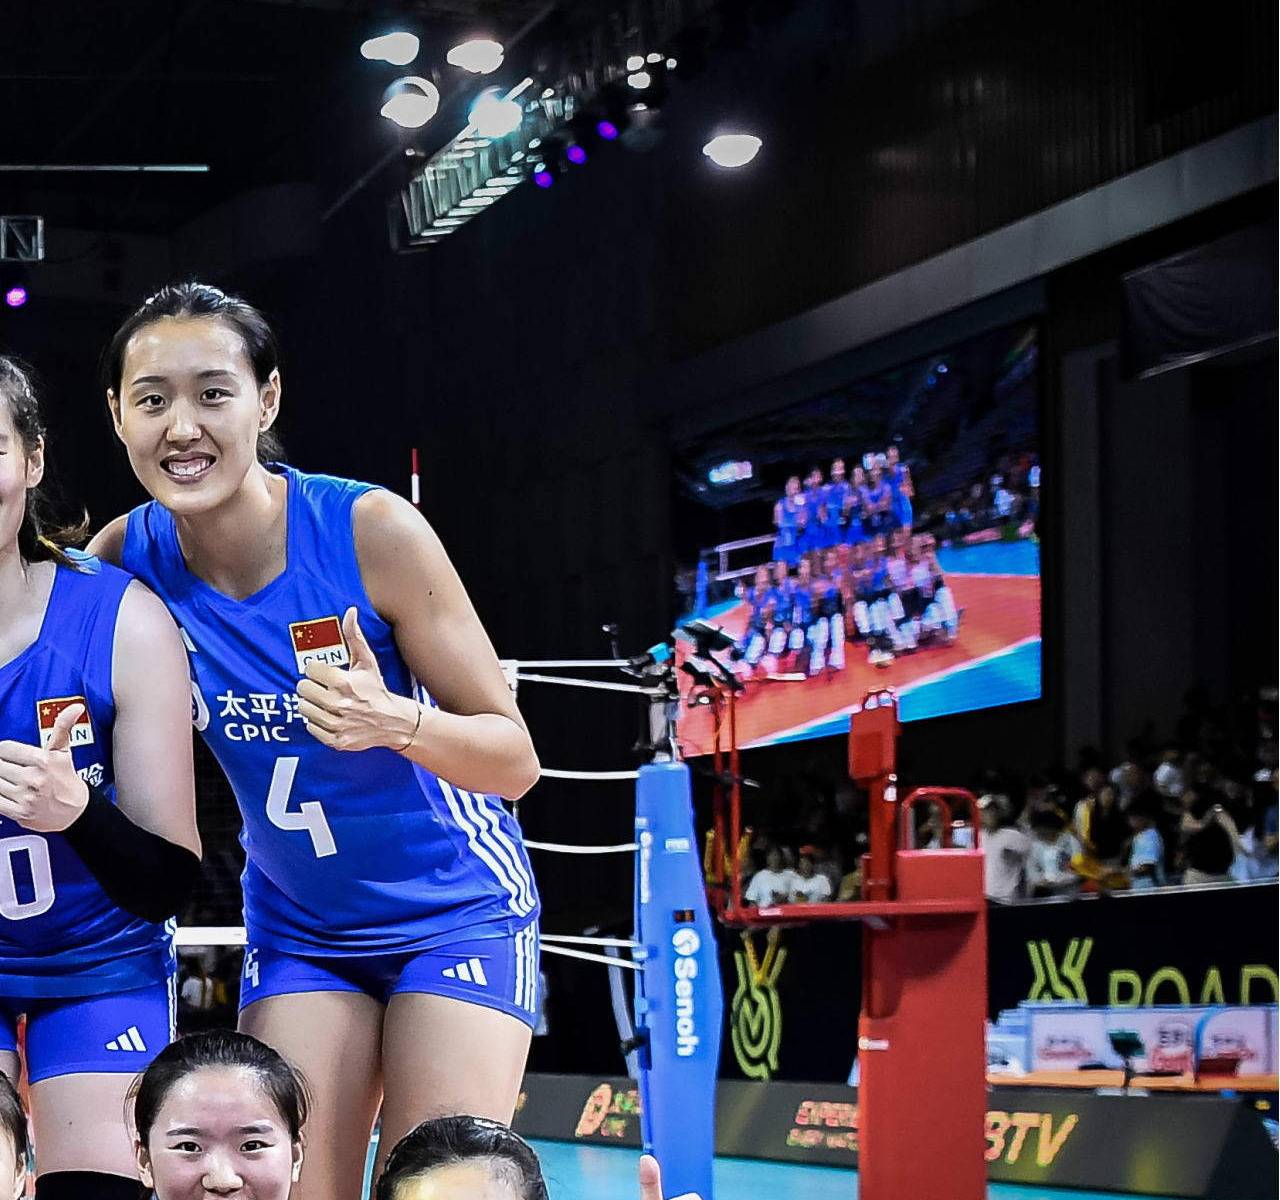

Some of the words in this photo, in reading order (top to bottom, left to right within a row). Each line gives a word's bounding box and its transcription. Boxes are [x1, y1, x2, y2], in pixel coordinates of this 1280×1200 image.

[217, 688, 310, 724] 太平洋
[225, 723, 291, 742] CPIC
[265, 756, 338, 858] 4
[674, 956, 700, 1057] Senoh
[984, 1110, 1080, 1168] BTV
